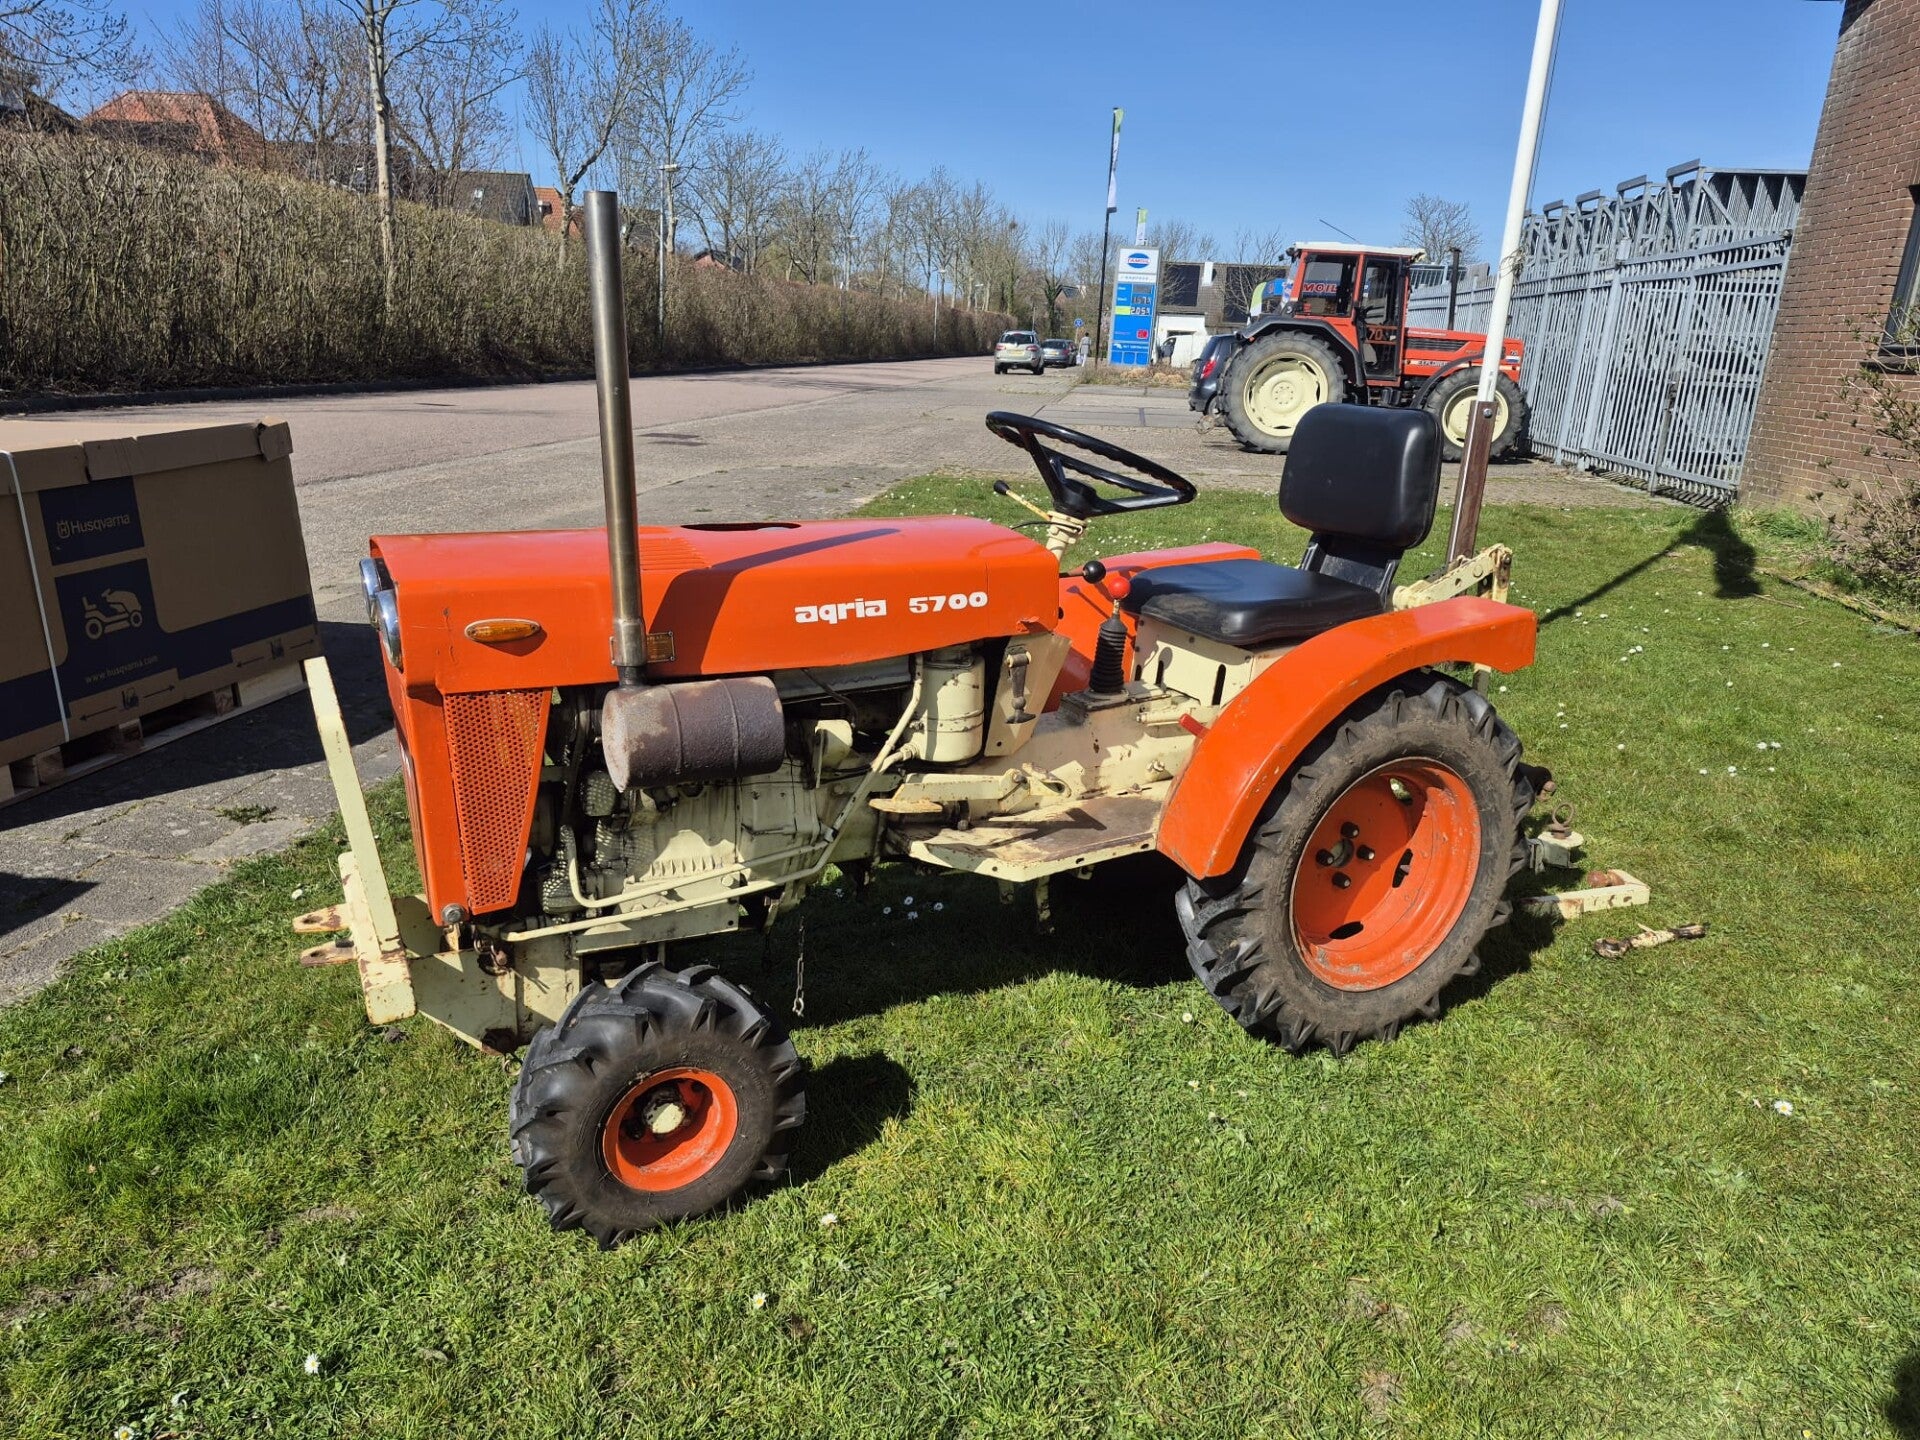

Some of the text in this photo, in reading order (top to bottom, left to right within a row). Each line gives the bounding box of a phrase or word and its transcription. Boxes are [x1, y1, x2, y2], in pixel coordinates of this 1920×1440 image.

[1302, 282, 1338, 293] MOIL
[70, 514, 130, 535] Husqvarna
[908, 591, 988, 614] 5700
[84, 655, 159, 684] www.husqvarna.com
